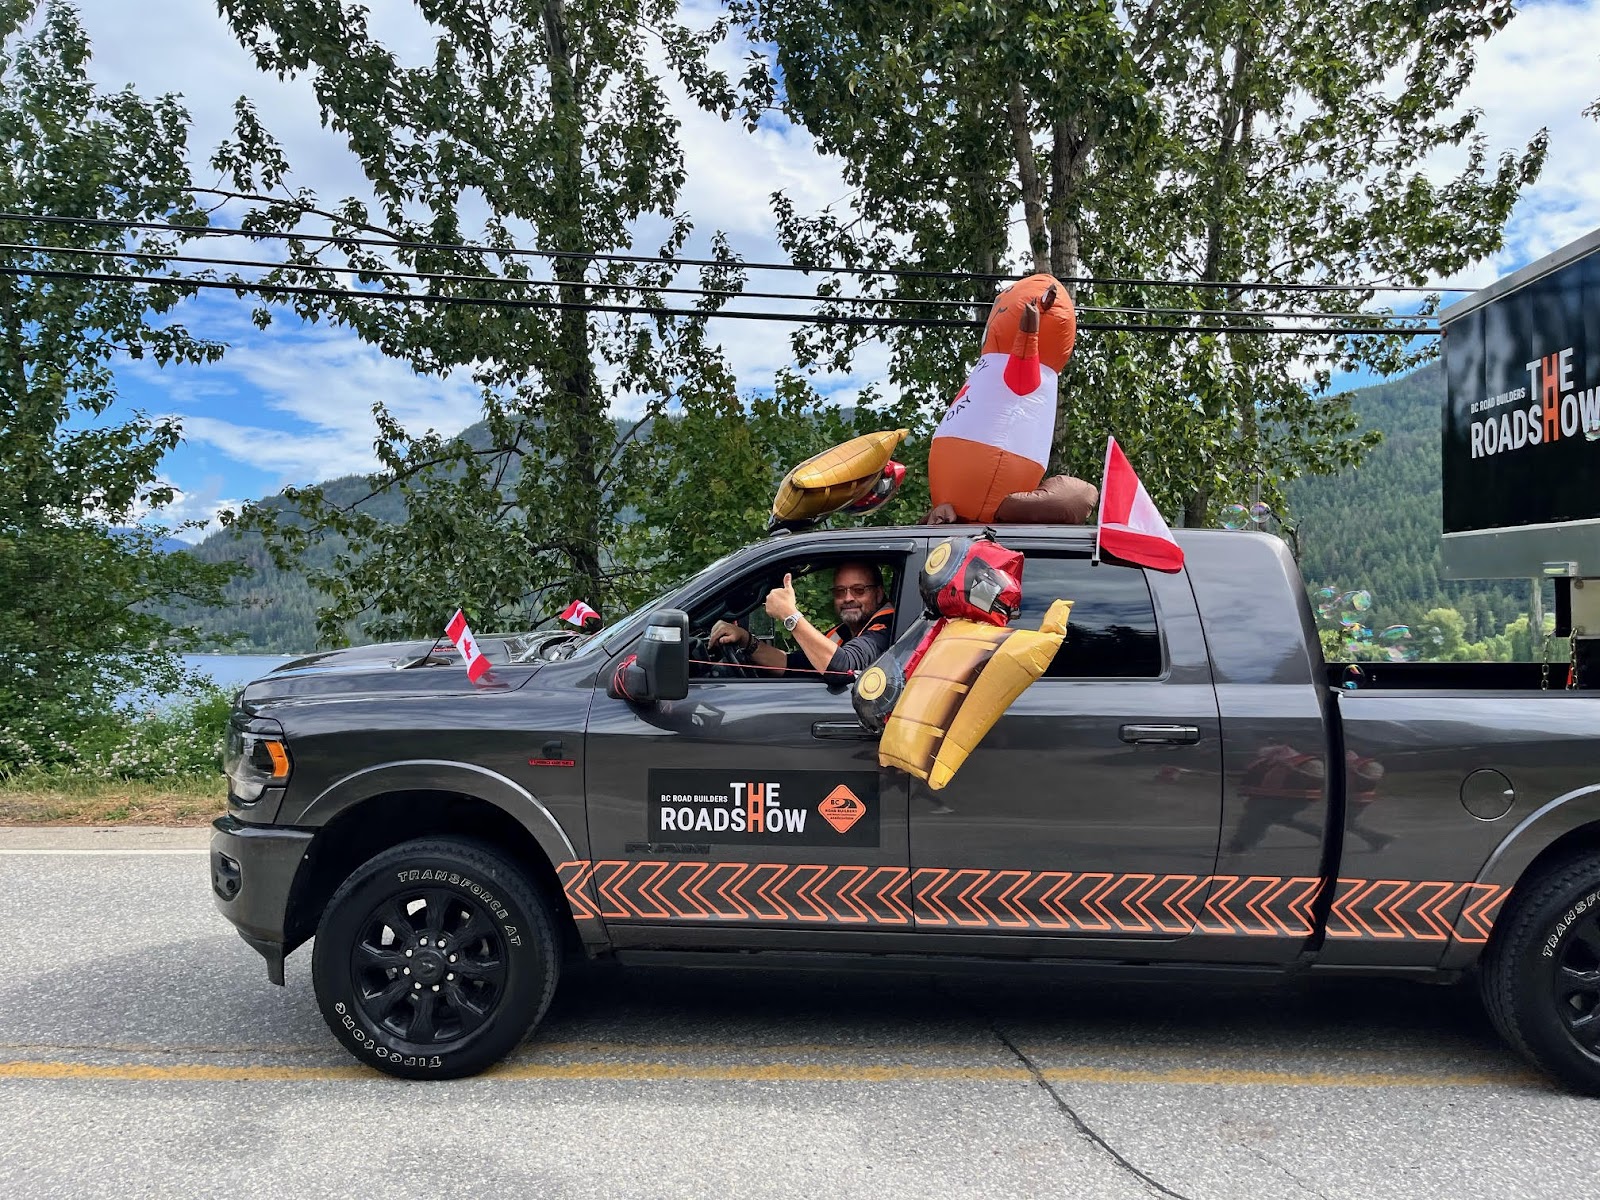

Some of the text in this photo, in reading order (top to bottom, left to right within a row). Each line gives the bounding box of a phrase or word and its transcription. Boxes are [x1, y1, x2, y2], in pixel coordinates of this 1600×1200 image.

[1526, 348, 1574, 401] THE
[946, 395, 971, 421] DAY
[1470, 386, 1526, 414] BC ROAD BUILDERS
[1470, 385, 1600, 459] ROADSHOW
[660, 794, 729, 803] BC ROAD BUILDERS
[730, 782, 781, 807] THE
[660, 806, 807, 833] ROADSHOW
[398, 869, 522, 946] TRANSFORCE AT
